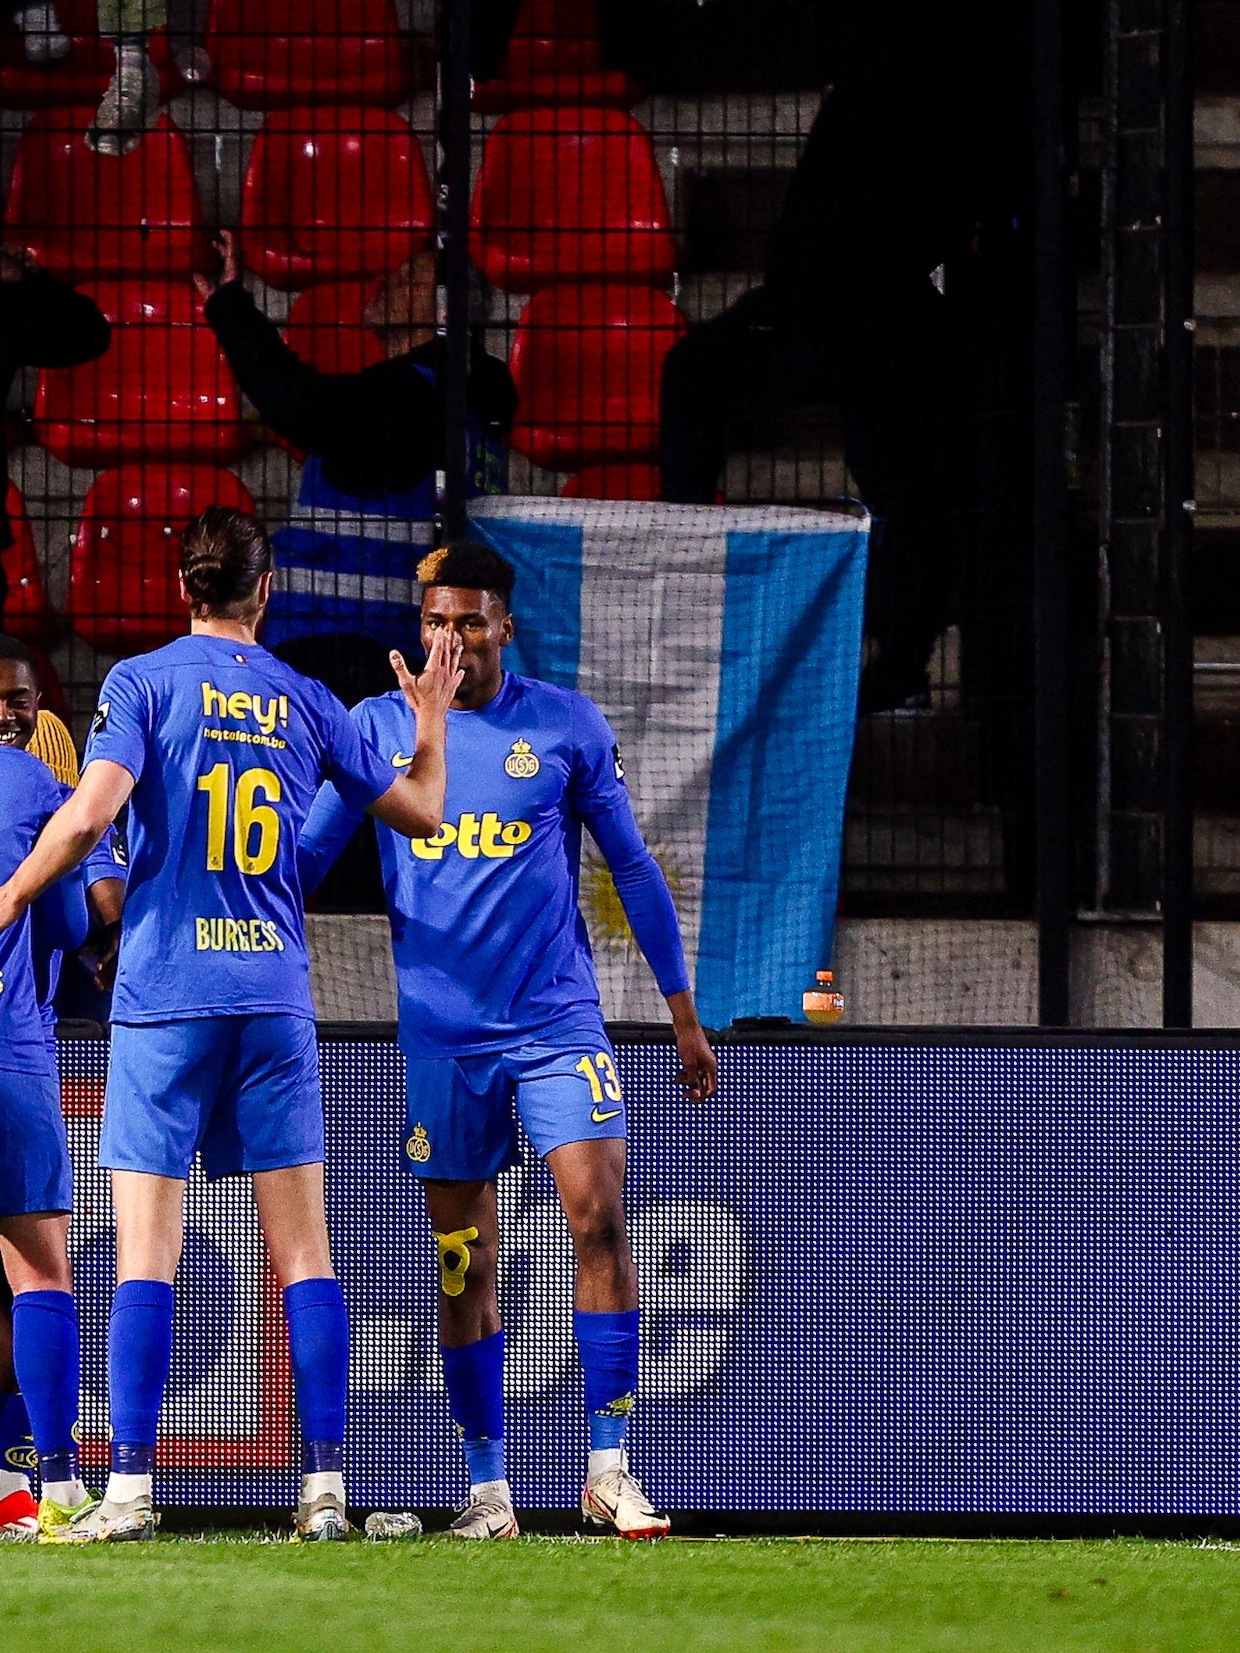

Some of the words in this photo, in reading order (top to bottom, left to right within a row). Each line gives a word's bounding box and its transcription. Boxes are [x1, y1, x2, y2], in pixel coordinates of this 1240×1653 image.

[200, 681, 289, 735] hey!
[203, 727, 287, 750] heytelecom.be
[197, 762, 282, 876] 16
[195, 917, 285, 952] BURGESS
[574, 1051, 623, 1104] 13
